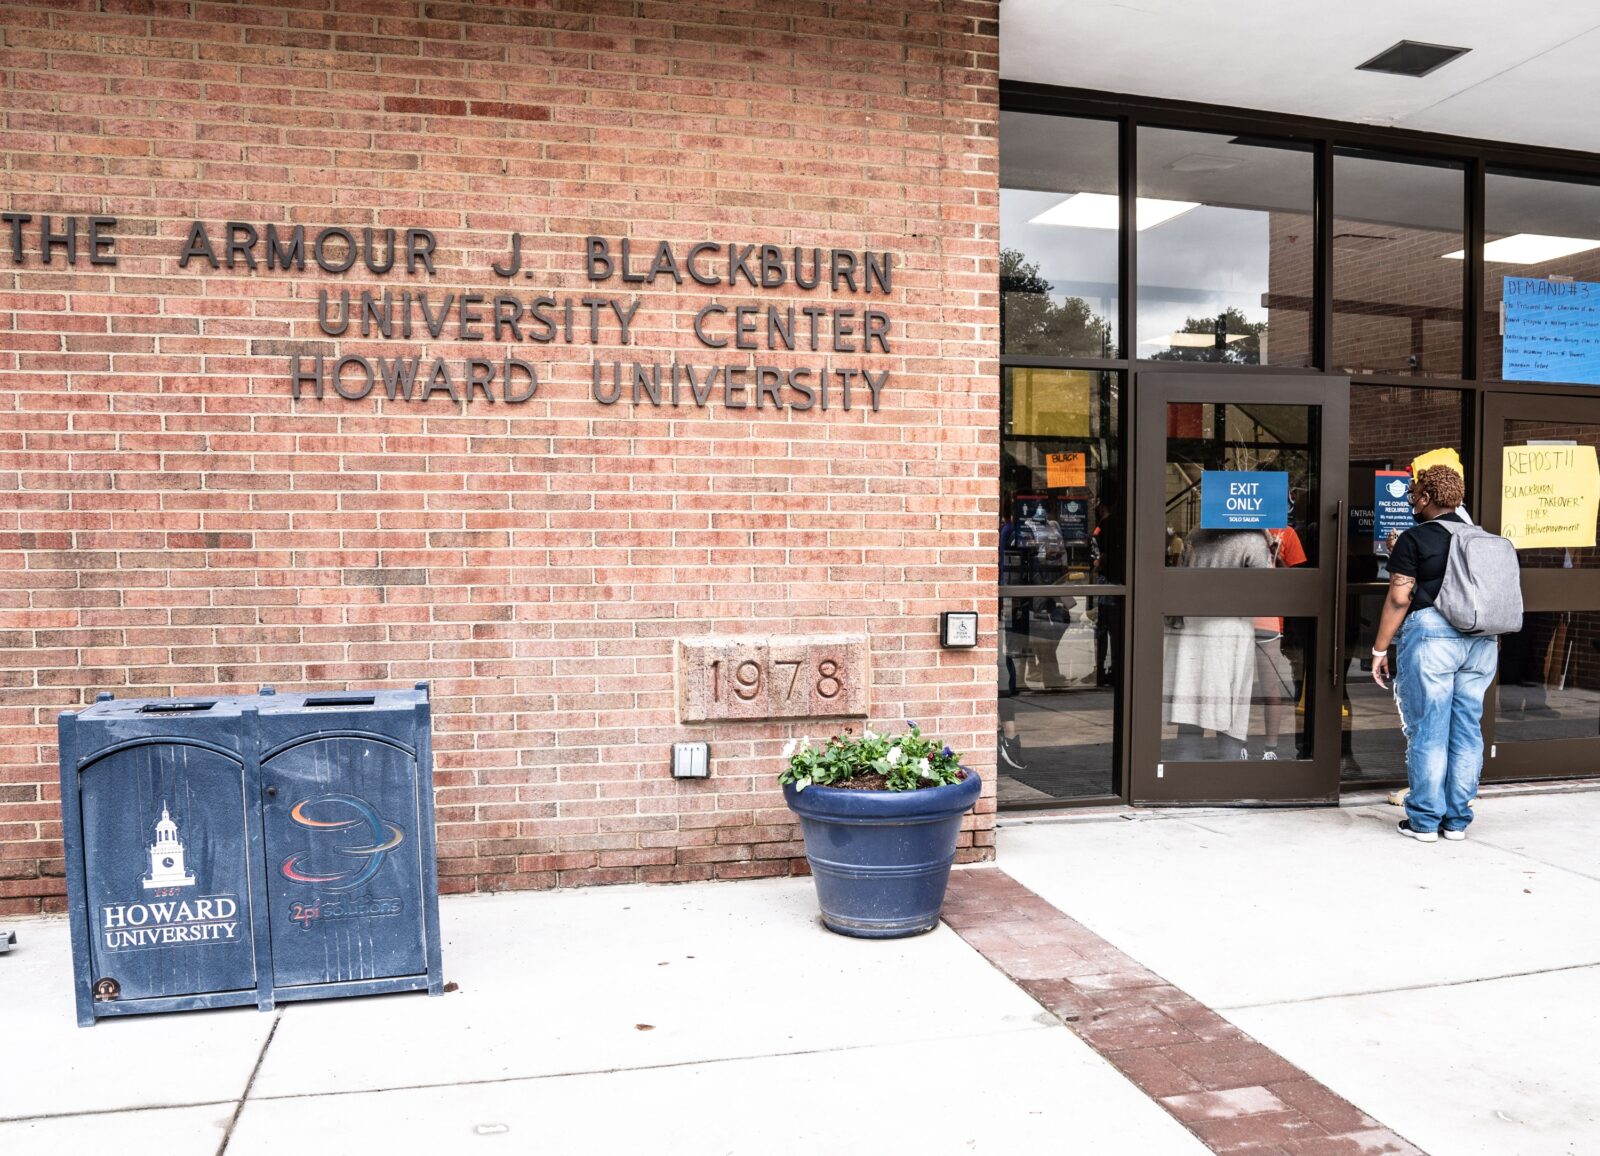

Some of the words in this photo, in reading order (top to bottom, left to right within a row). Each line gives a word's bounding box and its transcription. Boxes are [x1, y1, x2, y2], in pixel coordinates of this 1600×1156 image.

[1, 212, 118, 265] THE
[178, 220, 437, 275] ARMOUR
[492, 232, 535, 280] J.
[586, 235, 893, 294] BLACKBURN
[1508, 280, 1566, 296] DEMAND
[318, 288, 641, 345] UNIVERSITY
[694, 303, 891, 353] CENTER
[291, 353, 538, 403] HOWARD
[593, 359, 890, 412] UNIVERSITY
[1051, 453, 1078, 464] BLACK
[1230, 482, 1259, 496] EXIT
[1226, 497, 1263, 511] ONLY
[1350, 509, 1375, 517] ENTRAN
[709, 658, 843, 703] 1978
[103, 898, 237, 929] HOWARD
[104, 922, 238, 948] UNIVERSITY
